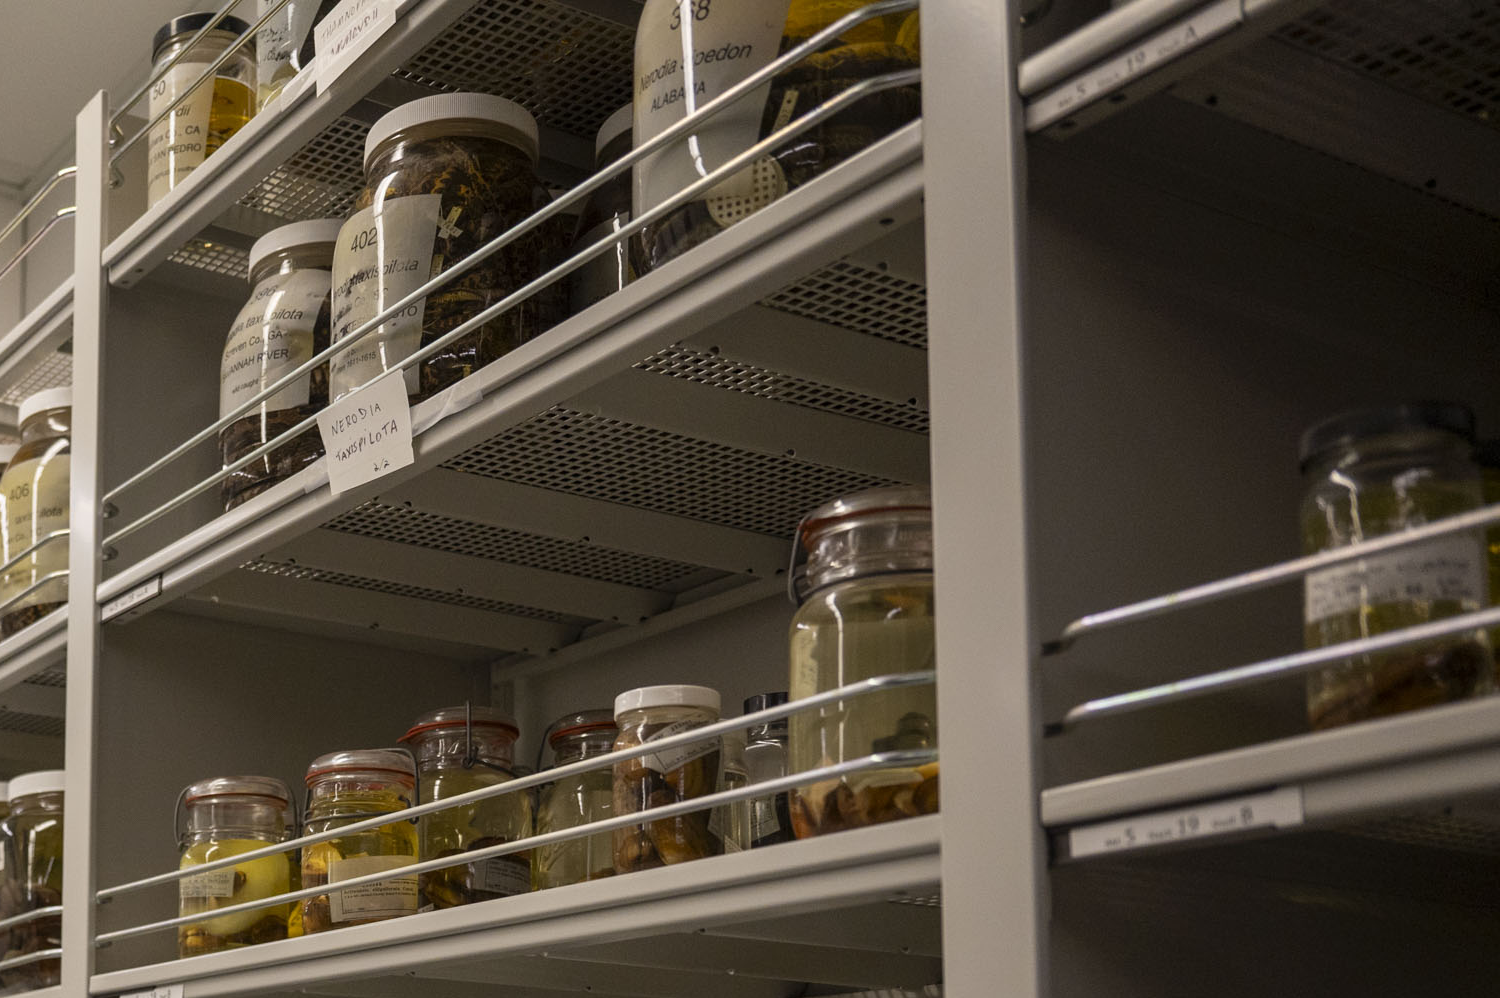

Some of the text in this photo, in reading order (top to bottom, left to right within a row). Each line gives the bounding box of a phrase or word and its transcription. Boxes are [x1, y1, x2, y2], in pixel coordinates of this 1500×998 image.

[680, 43, 753, 70] pedon
[350, 227, 377, 253] 402
[245, 308, 304, 328] taxipilota
[256, 348, 290, 361] RVER
[331, 402, 382, 437] NERODIA
